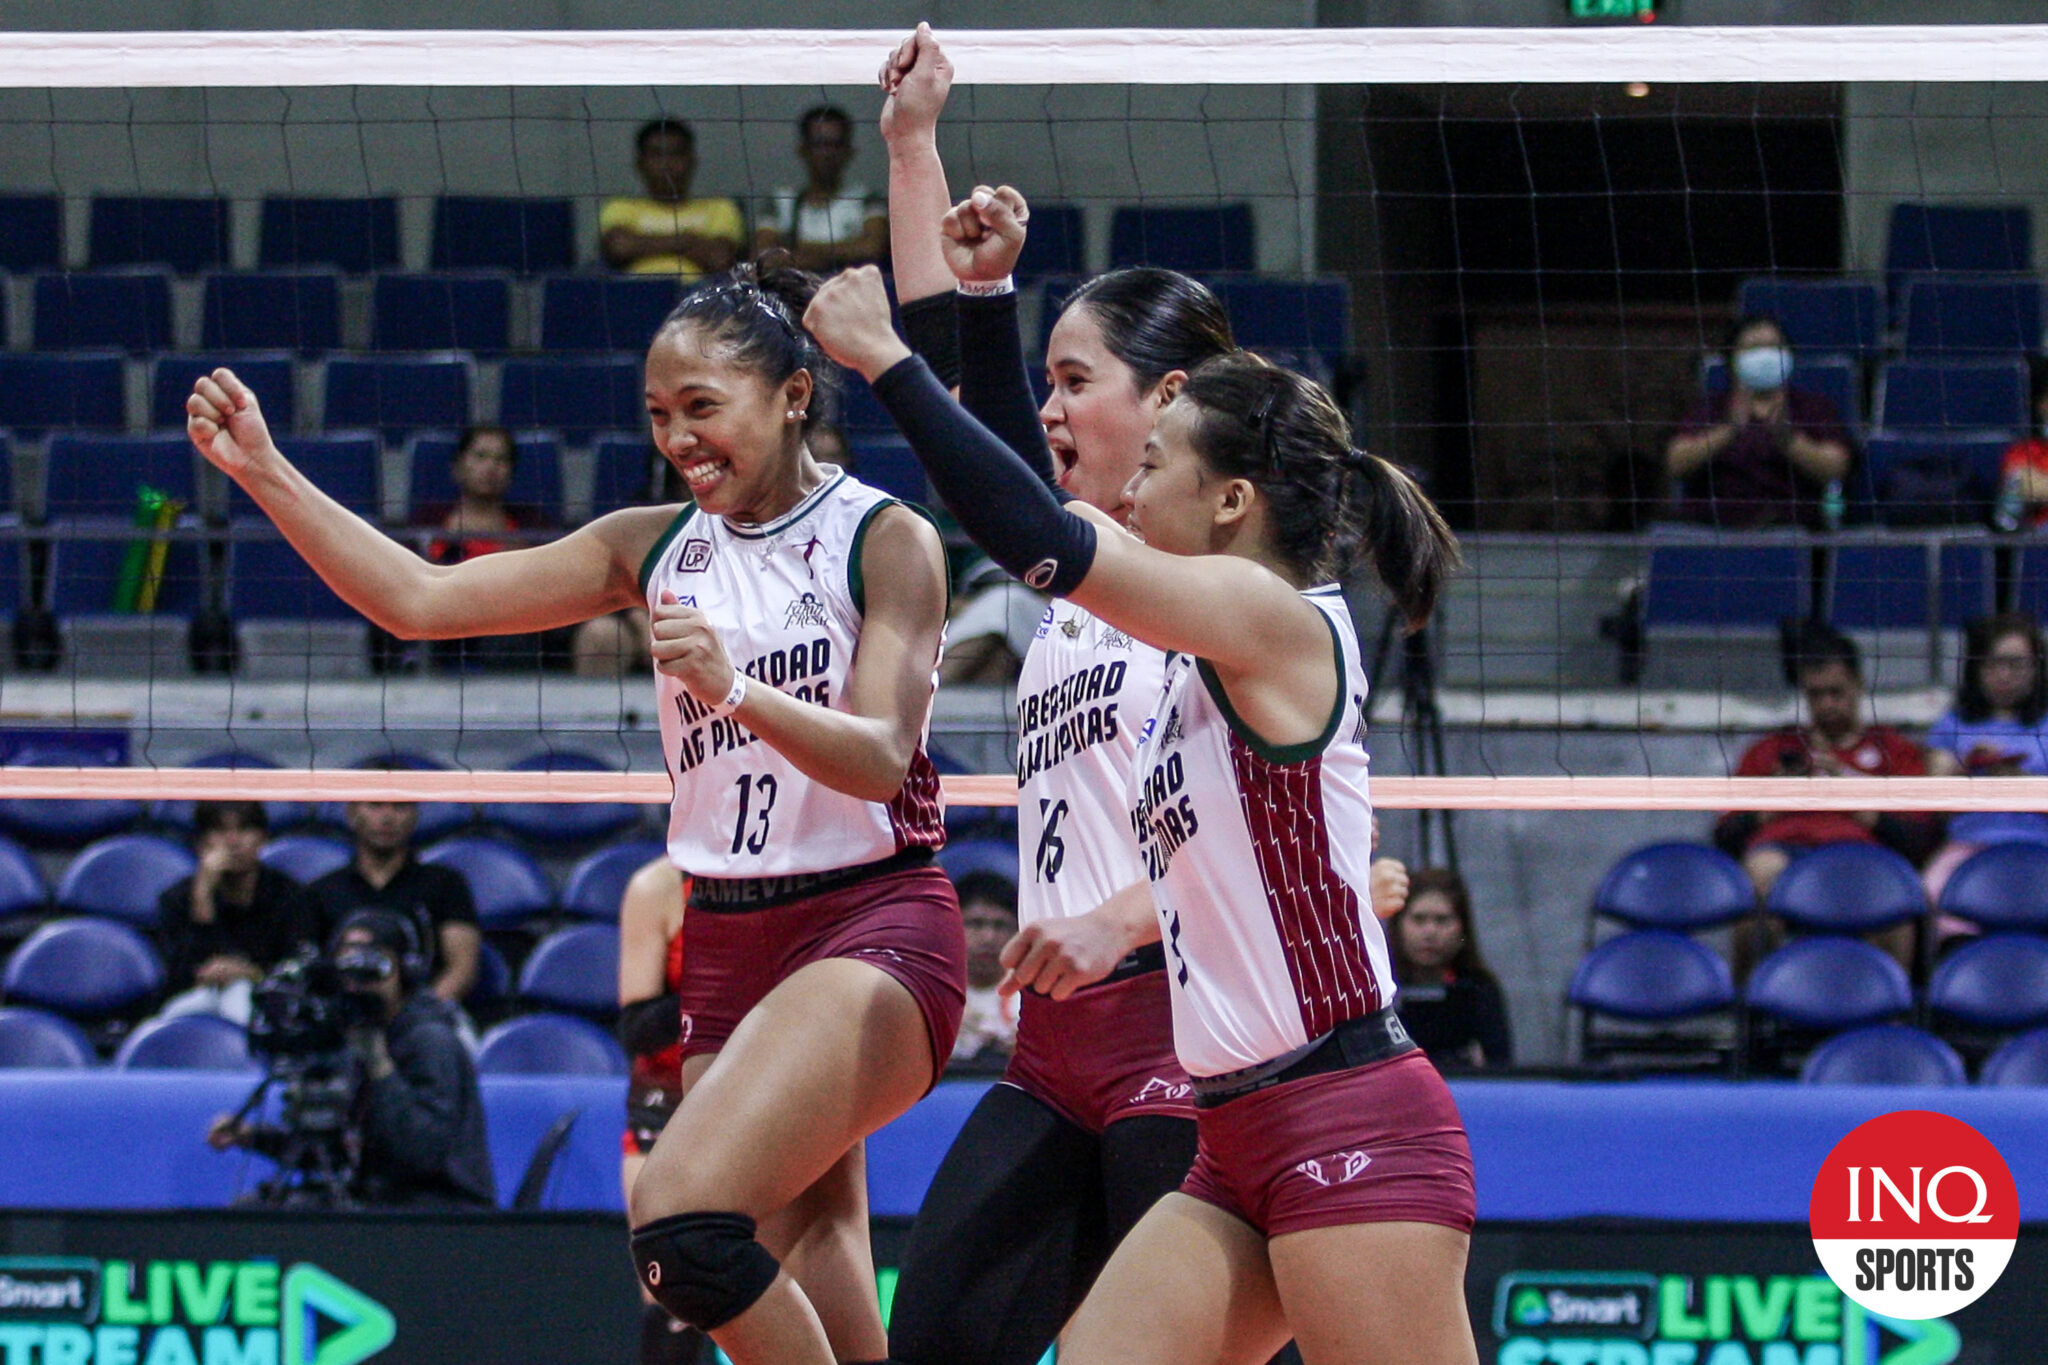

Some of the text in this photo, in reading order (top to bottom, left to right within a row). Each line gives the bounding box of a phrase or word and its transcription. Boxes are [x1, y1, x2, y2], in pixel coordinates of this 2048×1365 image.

[686, 553, 704, 567] UP
[1018, 660, 1128, 738] IBERSIDAD
[731, 774, 778, 856] 13
[0, 1260, 281, 1326] Smart LIVE
[1549, 1273, 1842, 1342] Smart LIVE
